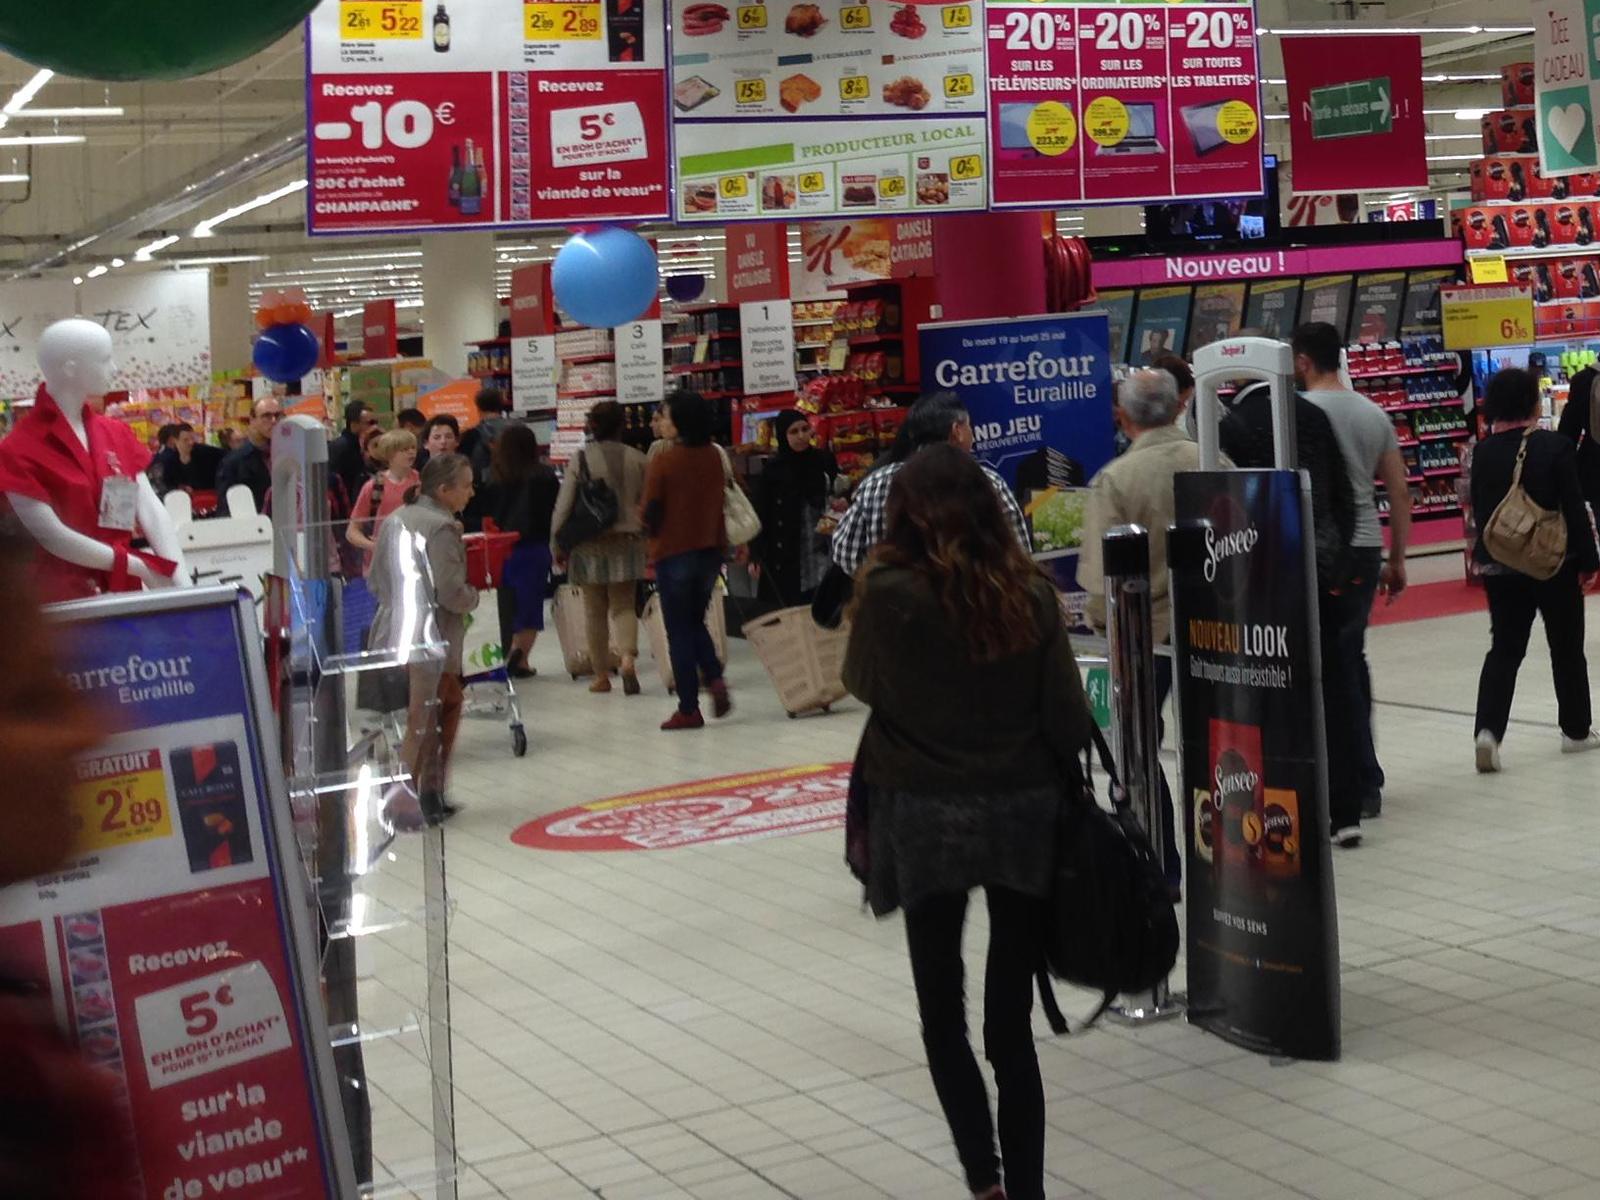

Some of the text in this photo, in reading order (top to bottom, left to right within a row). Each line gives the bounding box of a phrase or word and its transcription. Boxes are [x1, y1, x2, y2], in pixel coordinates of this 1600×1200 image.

[1011, 59, 1053, 71] SUR LES
[1101, 59, 1143, 71] SUR LES
[1183, 57, 1242, 69] SUR TOUTES
[1542, 53, 1584, 84] CADEAU
[322, 83, 394, 96] Recevez
[538, 81, 604, 92] Recevez
[1171, 76, 1192, 87] LES
[801, 125, 976, 158] PRODUCTEUR LOCAL
[350, 175, 405, 188] d'achat
[579, 168, 622, 181] sur la
[537, 186, 589, 199] viande
[592, 186, 610, 197] de
[896, 221, 920, 241] DANS
[890, 241, 933, 263] CATALOG
[1165, 251, 1286, 279] Nouveau !
[94, 308, 157, 332] TEX
[761, 306, 769, 320] 1
[632, 325, 643, 339] 3
[527, 340, 538, 353] 5
[935, 351, 1096, 387] Carrefour
[1014, 381, 1097, 405] Euralille
[1203, 522, 1259, 582] Senseo
[1189, 619, 1289, 657] NOUVEAU LOOK
[65, 654, 192, 691] arrefour
[118, 680, 196, 704] Euralille
[75, 751, 151, 778] GRATUIT
[1247, 918, 1268, 936] SENS
[128, 940, 229, 975] Recevez
[151, 1051, 172, 1067] EN
[174, 1041, 209, 1062] BON
[161, 1060, 194, 1076] POUR
[181, 1082, 266, 1122] sur la
[177, 1117, 283, 1161] viande
[163, 1176, 203, 1200] de
